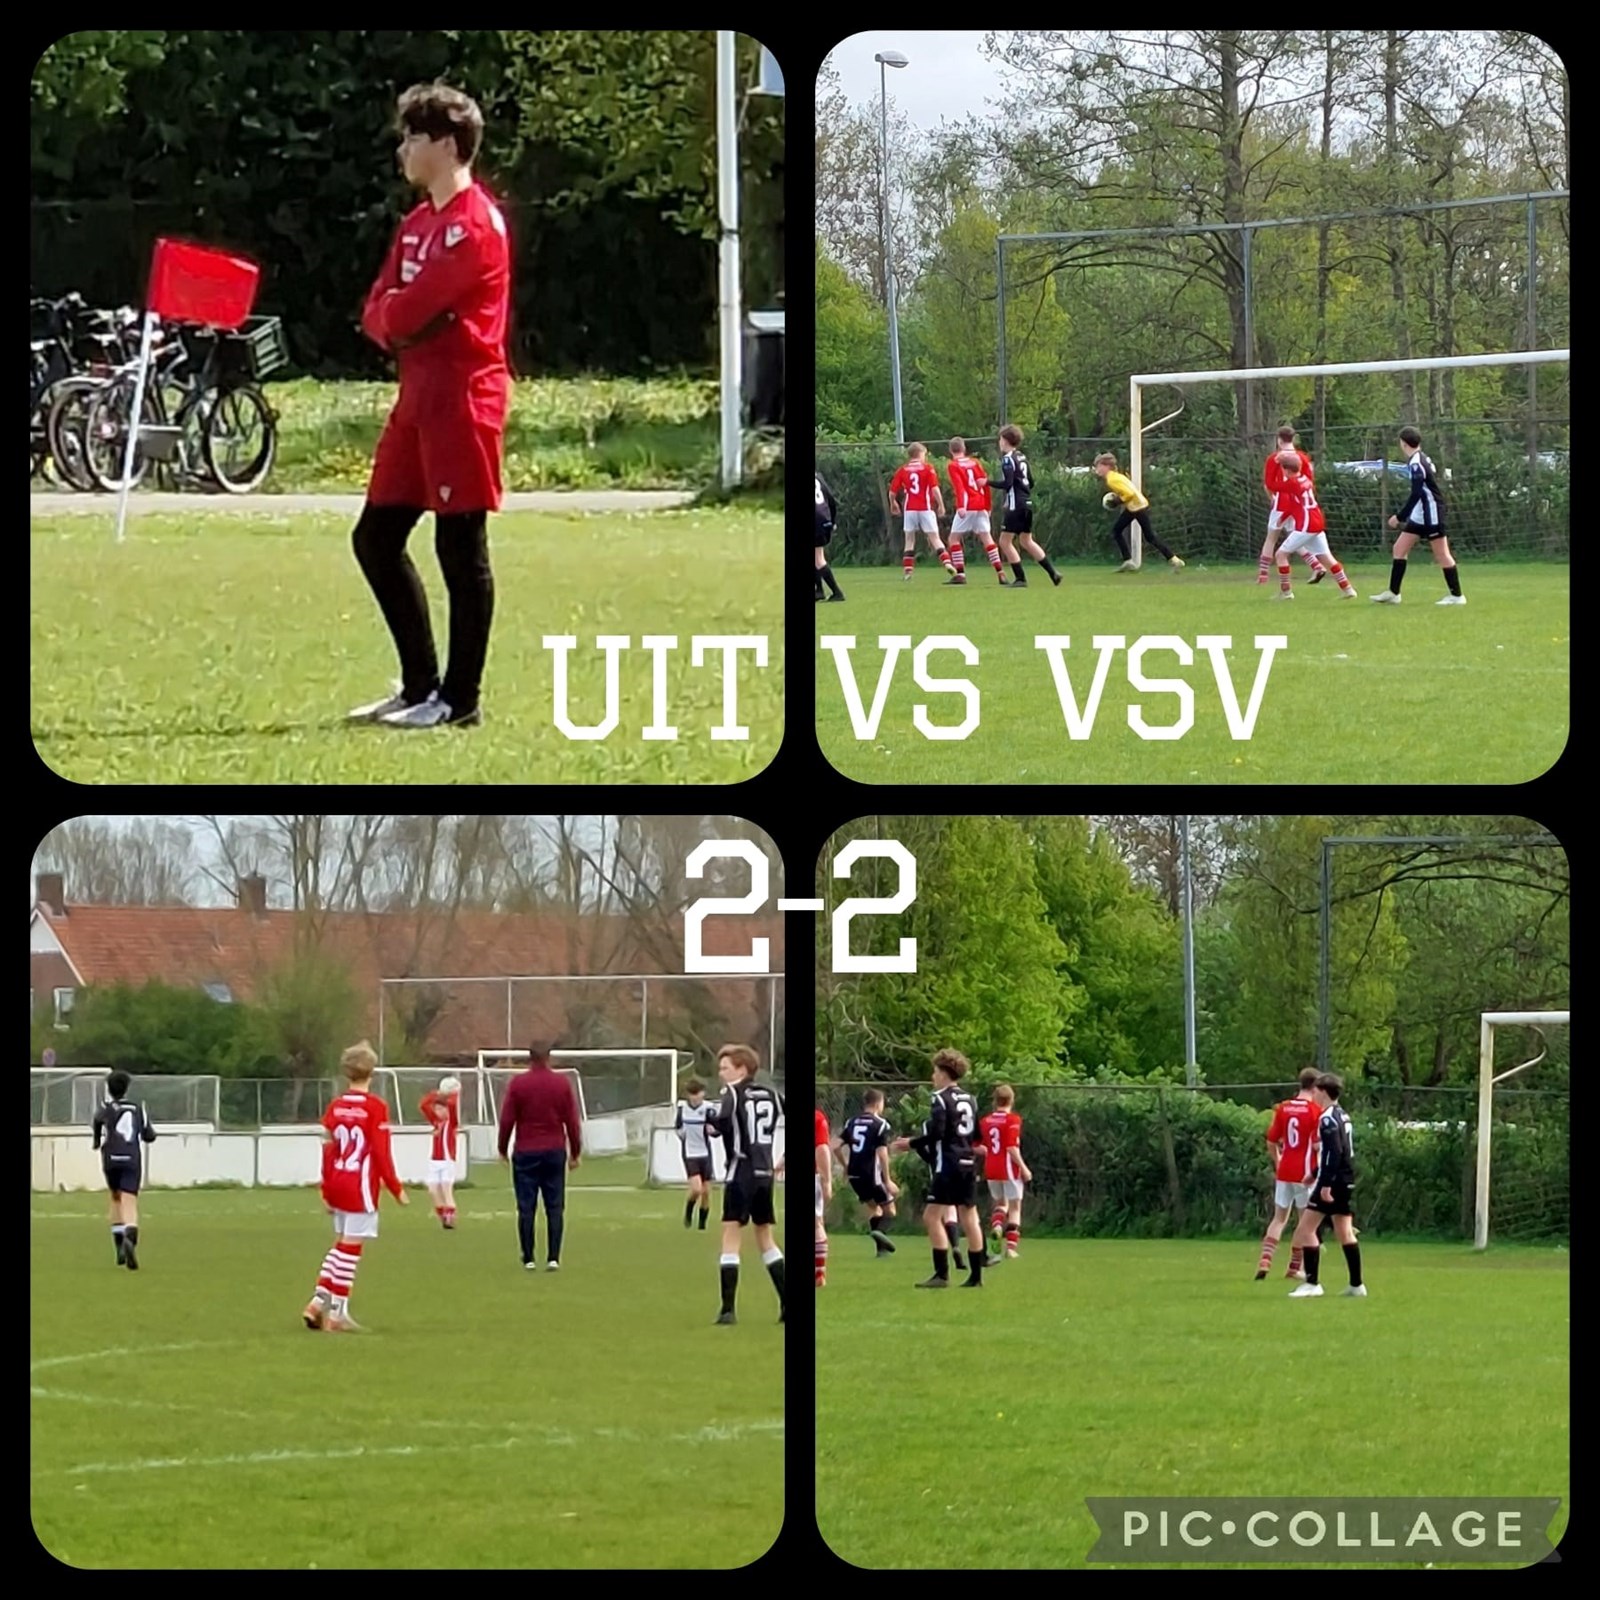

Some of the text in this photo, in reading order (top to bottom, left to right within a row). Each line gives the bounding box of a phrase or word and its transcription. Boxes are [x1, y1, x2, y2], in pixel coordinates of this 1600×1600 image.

[909, 472, 920, 495] 3
[116, 1110, 133, 1142] 4
[745, 1100, 774, 1144] 12
[956, 1101, 974, 1135] 3
[1287, 1116, 1299, 1148] 6
[852, 1125, 868, 1153] 5
[989, 1127, 1000, 1155] 3
